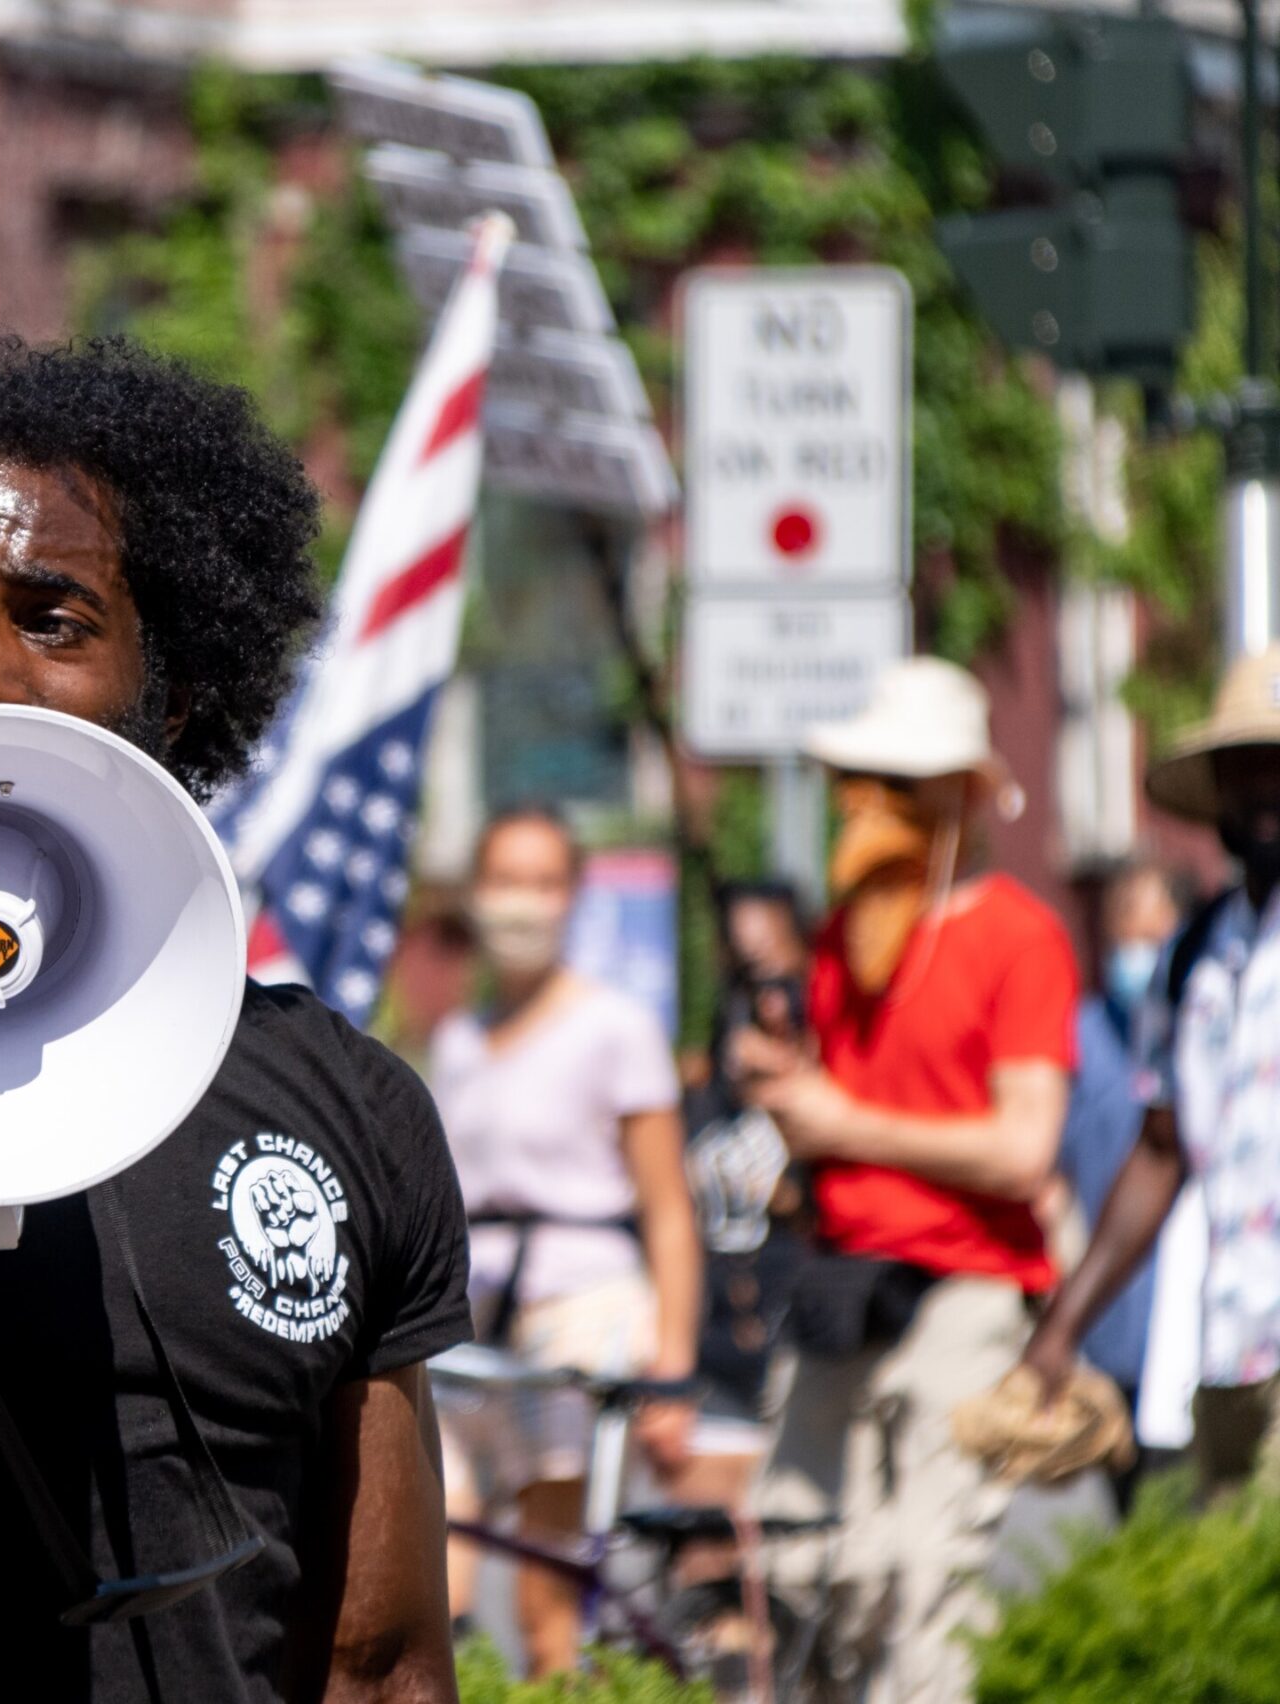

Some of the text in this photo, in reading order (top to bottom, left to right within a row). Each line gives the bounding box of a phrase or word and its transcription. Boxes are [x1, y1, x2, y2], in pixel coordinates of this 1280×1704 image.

[212, 1132, 348, 1223] LAST CHANCE
[218, 1237, 266, 1300] FOR
